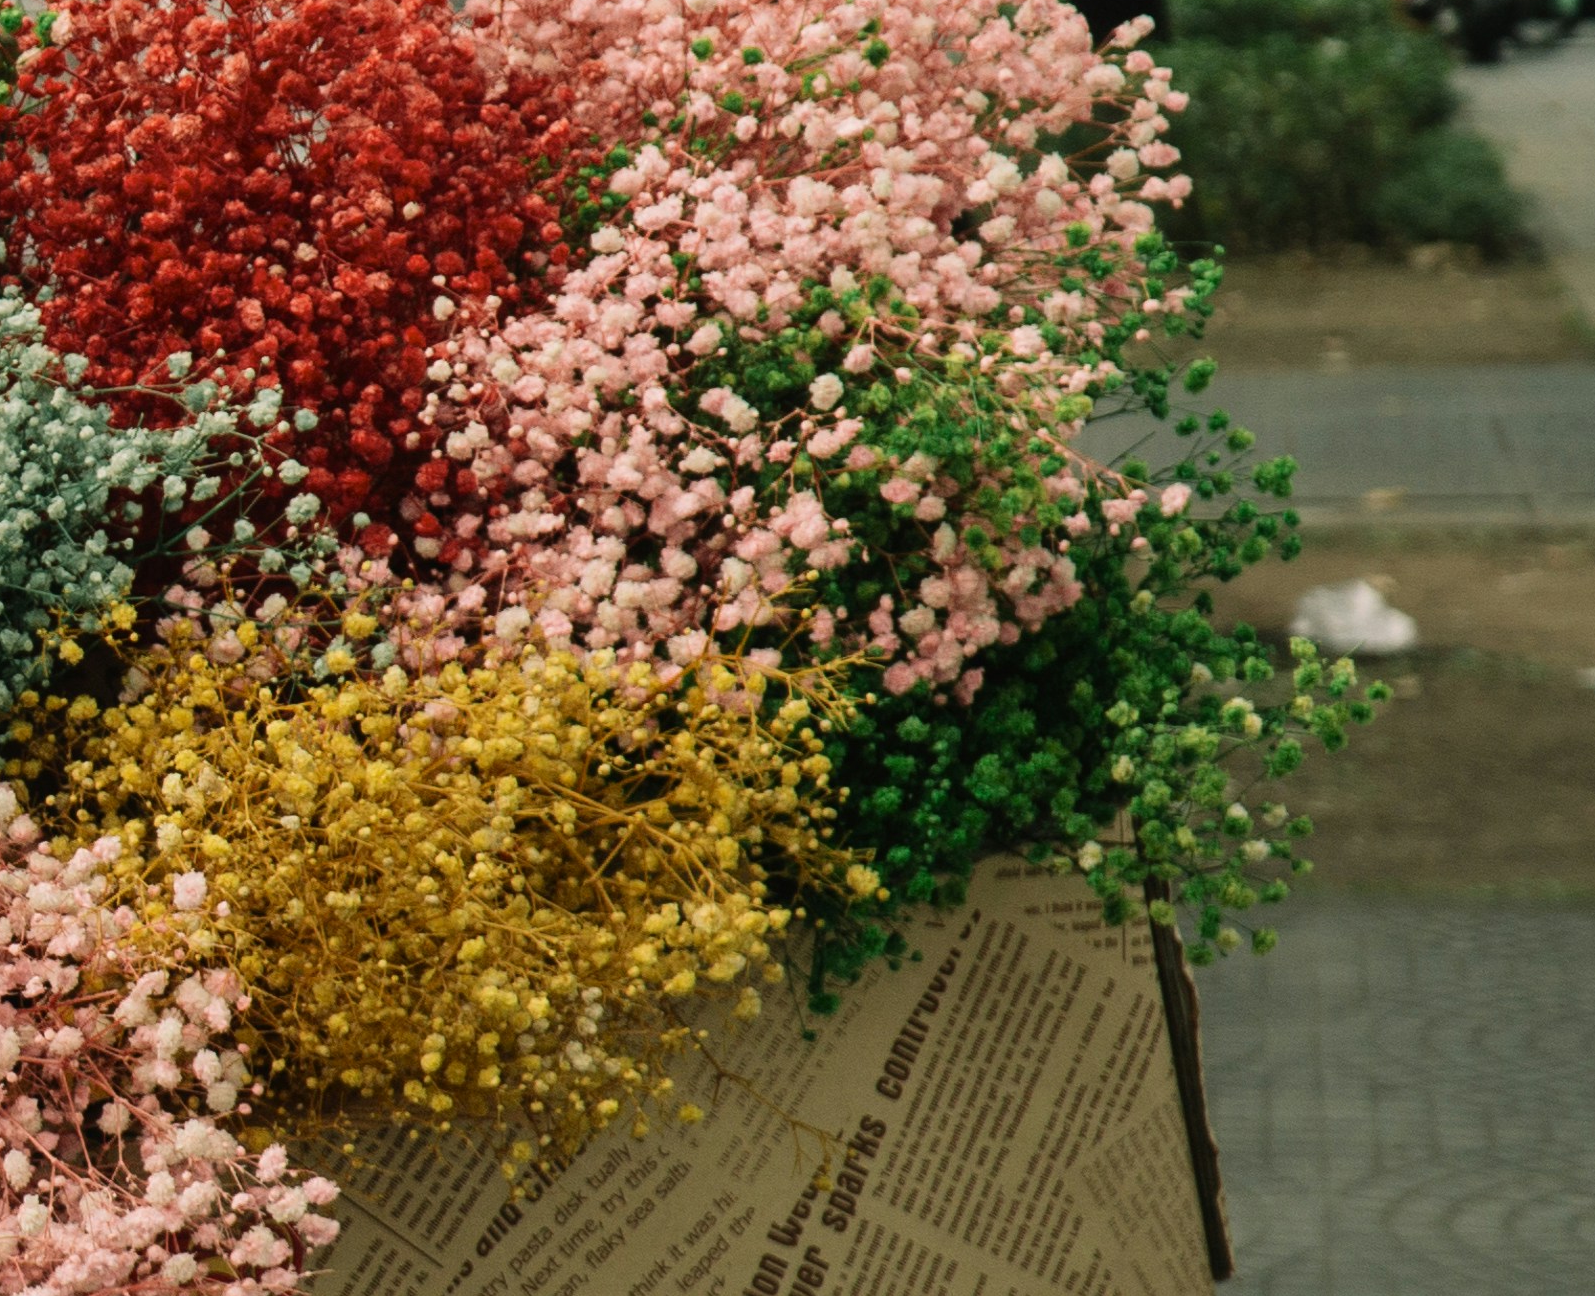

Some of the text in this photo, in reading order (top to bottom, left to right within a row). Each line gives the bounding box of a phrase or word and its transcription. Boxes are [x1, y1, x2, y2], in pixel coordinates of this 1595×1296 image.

[507, 1225, 554, 1276] pasta
[553, 1189, 588, 1226] disk
[584, 1143, 631, 1191] tually
[557, 1218, 604, 1258] time,
[599, 1186, 627, 1215] try
[624, 1156, 658, 1190] this
[820, 1113, 887, 1234] sparks
[584, 1226, 626, 1269] flaky
[625, 1196, 656, 1229] sea
[666, 1243, 685, 1262] it
[682, 1210, 717, 1247] was
[674, 1233, 731, 1293] leaped
